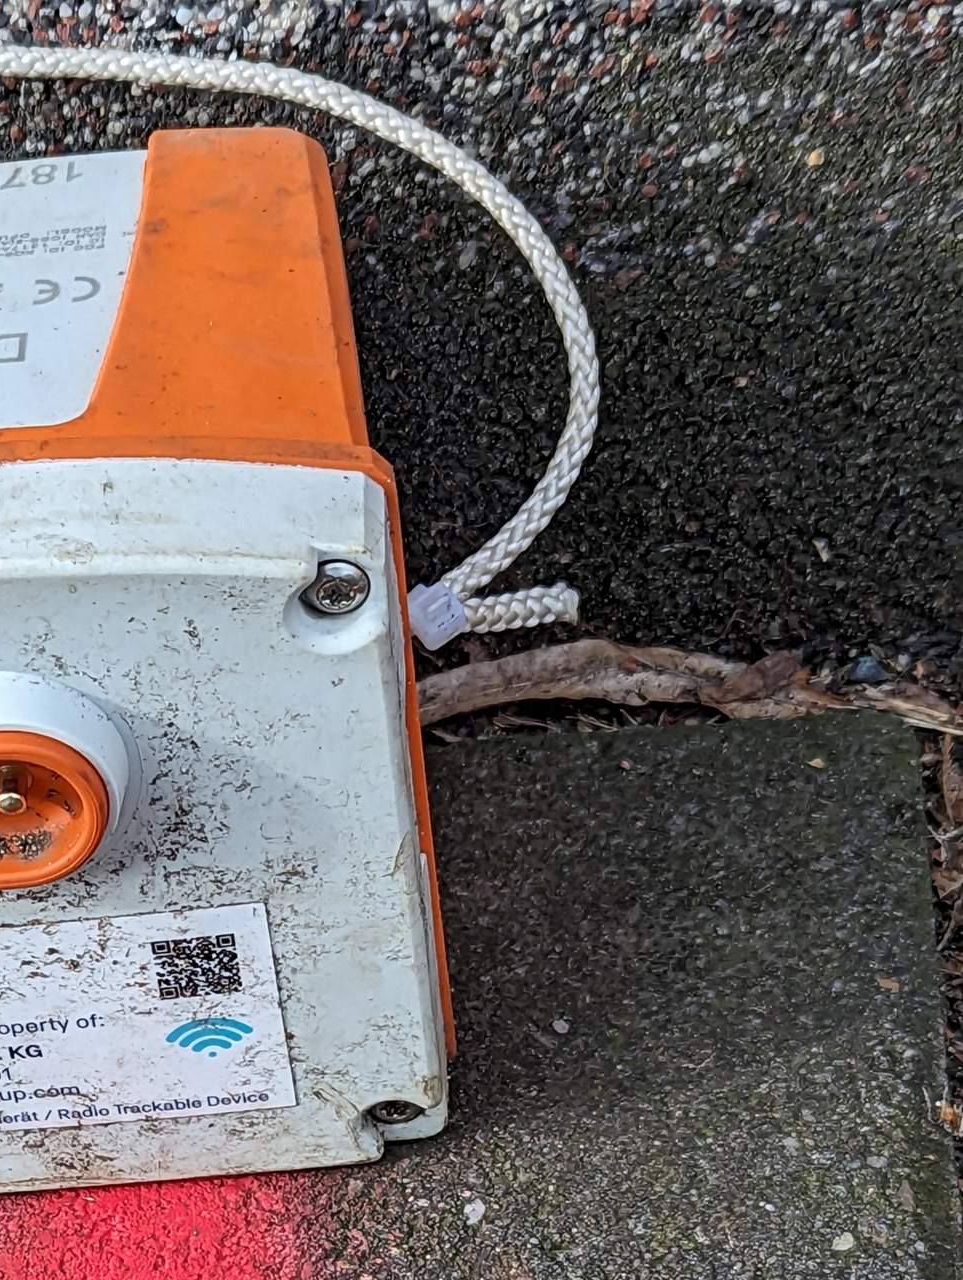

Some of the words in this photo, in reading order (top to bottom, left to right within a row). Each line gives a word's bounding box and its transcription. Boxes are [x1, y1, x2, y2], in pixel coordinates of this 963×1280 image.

[76, 1013, 105, 1029] of:
[9, 1044, 44, 1060] KG
[57, 1104, 110, 1121] Radio
[114, 1097, 202, 1116] Trackable
[207, 1090, 270, 1107] Device
